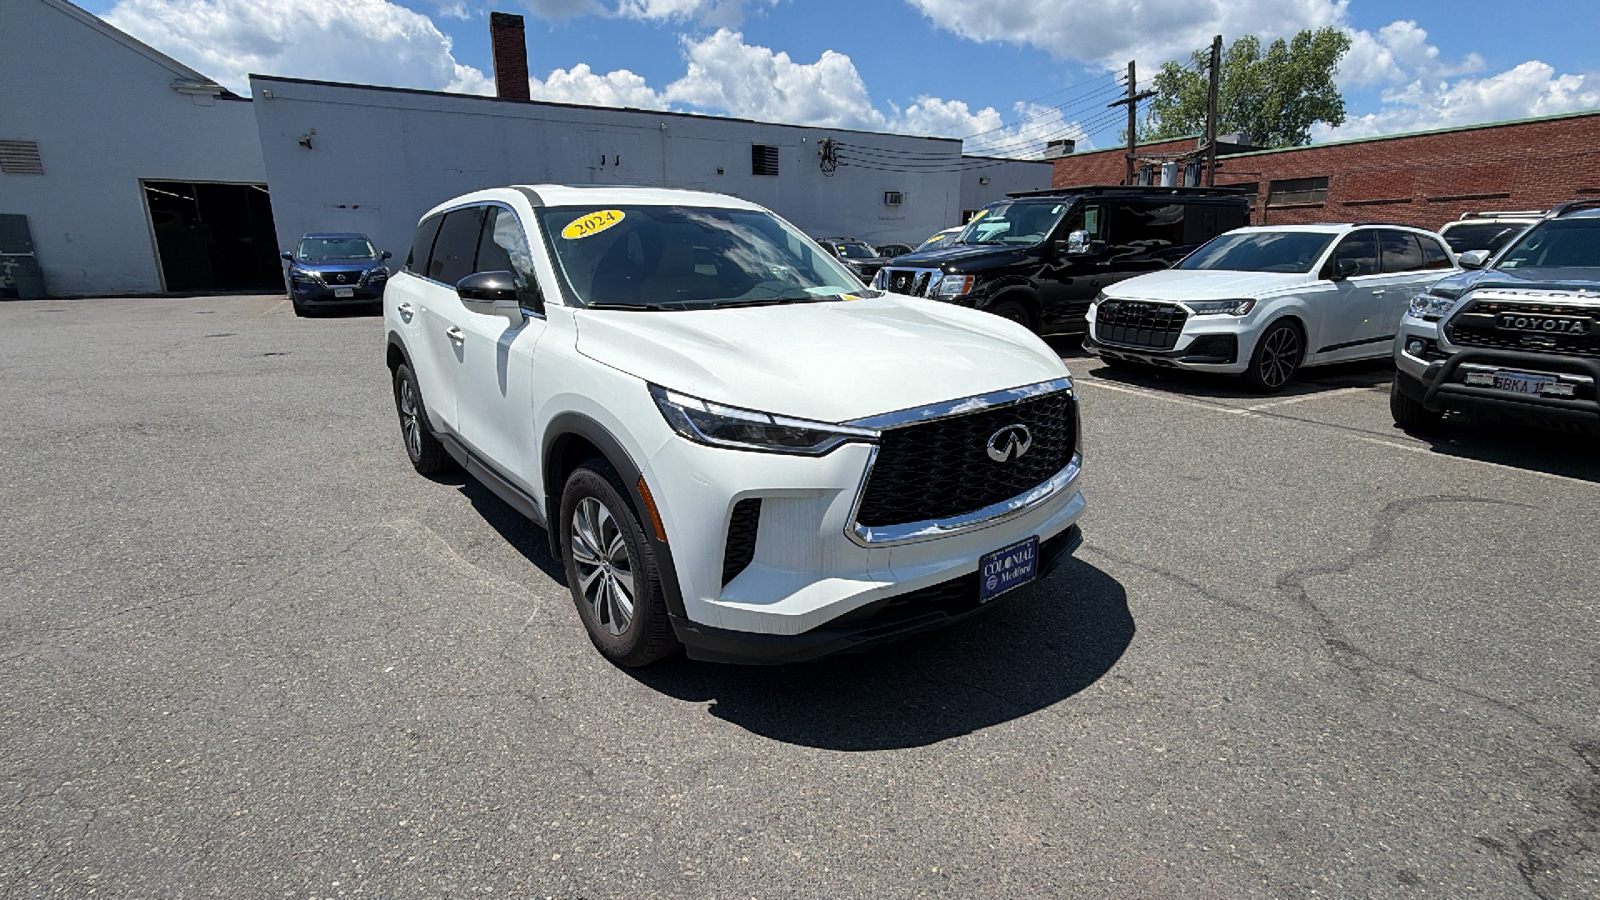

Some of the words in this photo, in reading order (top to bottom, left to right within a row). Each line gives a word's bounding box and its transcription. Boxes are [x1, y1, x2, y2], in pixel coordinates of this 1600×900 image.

[574, 211, 615, 235] 2024
[1503, 316, 1584, 333] TOYOTA
[984, 547, 1034, 577] COLONIAL
[1001, 561, 1032, 584] Medford
